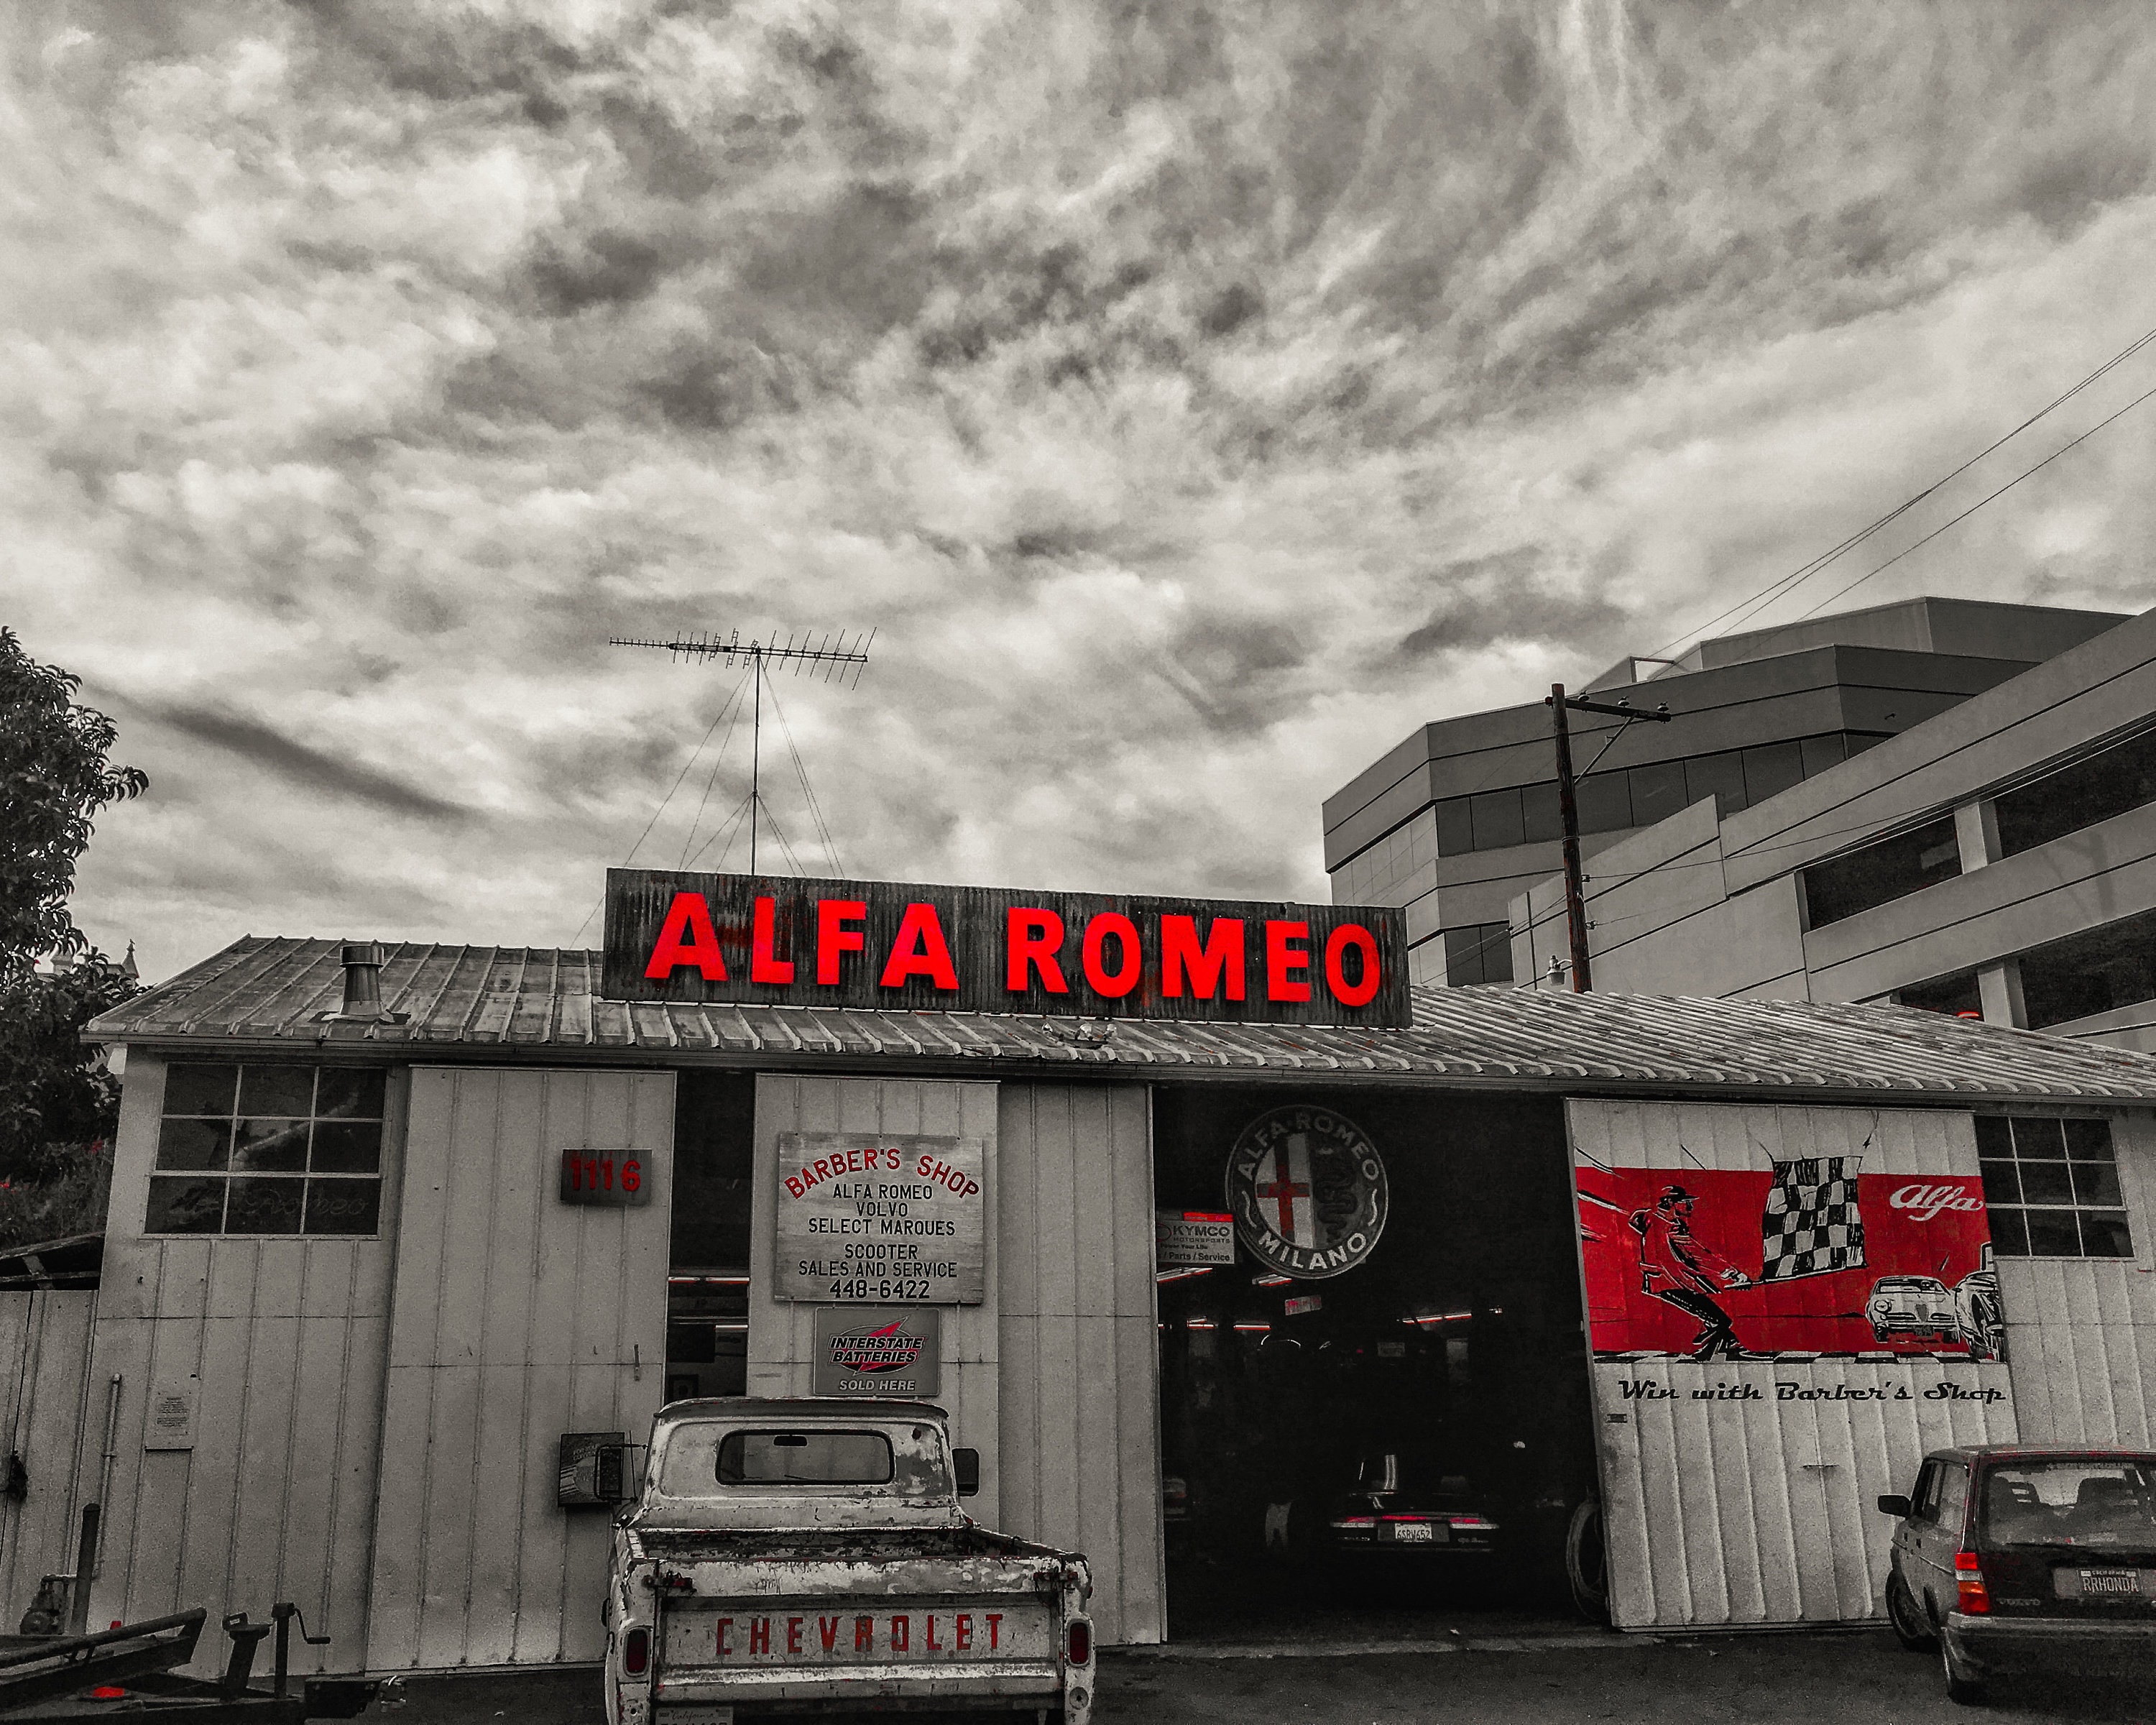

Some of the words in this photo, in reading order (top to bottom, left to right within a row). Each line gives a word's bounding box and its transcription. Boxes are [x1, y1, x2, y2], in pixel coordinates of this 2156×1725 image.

[644, 893, 959, 990] ALFA
[1007, 907, 1381, 1006] ROMEO
[1296, 1113, 1379, 1180] ROMEO
[571, 1159, 641, 1192] 1116
[784, 1148, 901, 1199] BARBER'S
[917, 1155, 980, 1199] SHOP
[832, 1184, 872, 1199] ALFA
[879, 1184, 933, 1200] ROMEO
[856, 1202, 908, 1217] VOLVO
[1889, 1184, 1984, 1221] Alfa
[808, 1218, 872, 1234] SELECT
[880, 1221, 955, 1236] MARQUES
[1173, 1225, 1230, 1236] KYMCO
[844, 1243, 918, 1259] SCOOTER
[1169, 1251, 1192, 1260] Parts
[1198, 1252, 1230, 1261] Service
[1258, 1230, 1366, 1270] MILANO
[798, 1260, 849, 1276] SALES
[854, 1261, 886, 1276] AND
[893, 1262, 957, 1277] SERVICE
[829, 1279, 931, 1299] 448-6422
[829, 1336, 924, 1349] INTERSTATE
[832, 1350, 916, 1363] BATTERIES
[839, 1379, 875, 1391] SOLD
[879, 1379, 916, 1391] HERE
[1618, 1380, 1680, 1399] Win
[1692, 1382, 1764, 1400] with
[1774, 1381, 1913, 1400] Barber's
[1923, 1381, 2006, 1404] Shop
[2082, 1577, 2139, 1592] RRHONDA
[717, 1614, 1003, 1655] CHEVROLET
